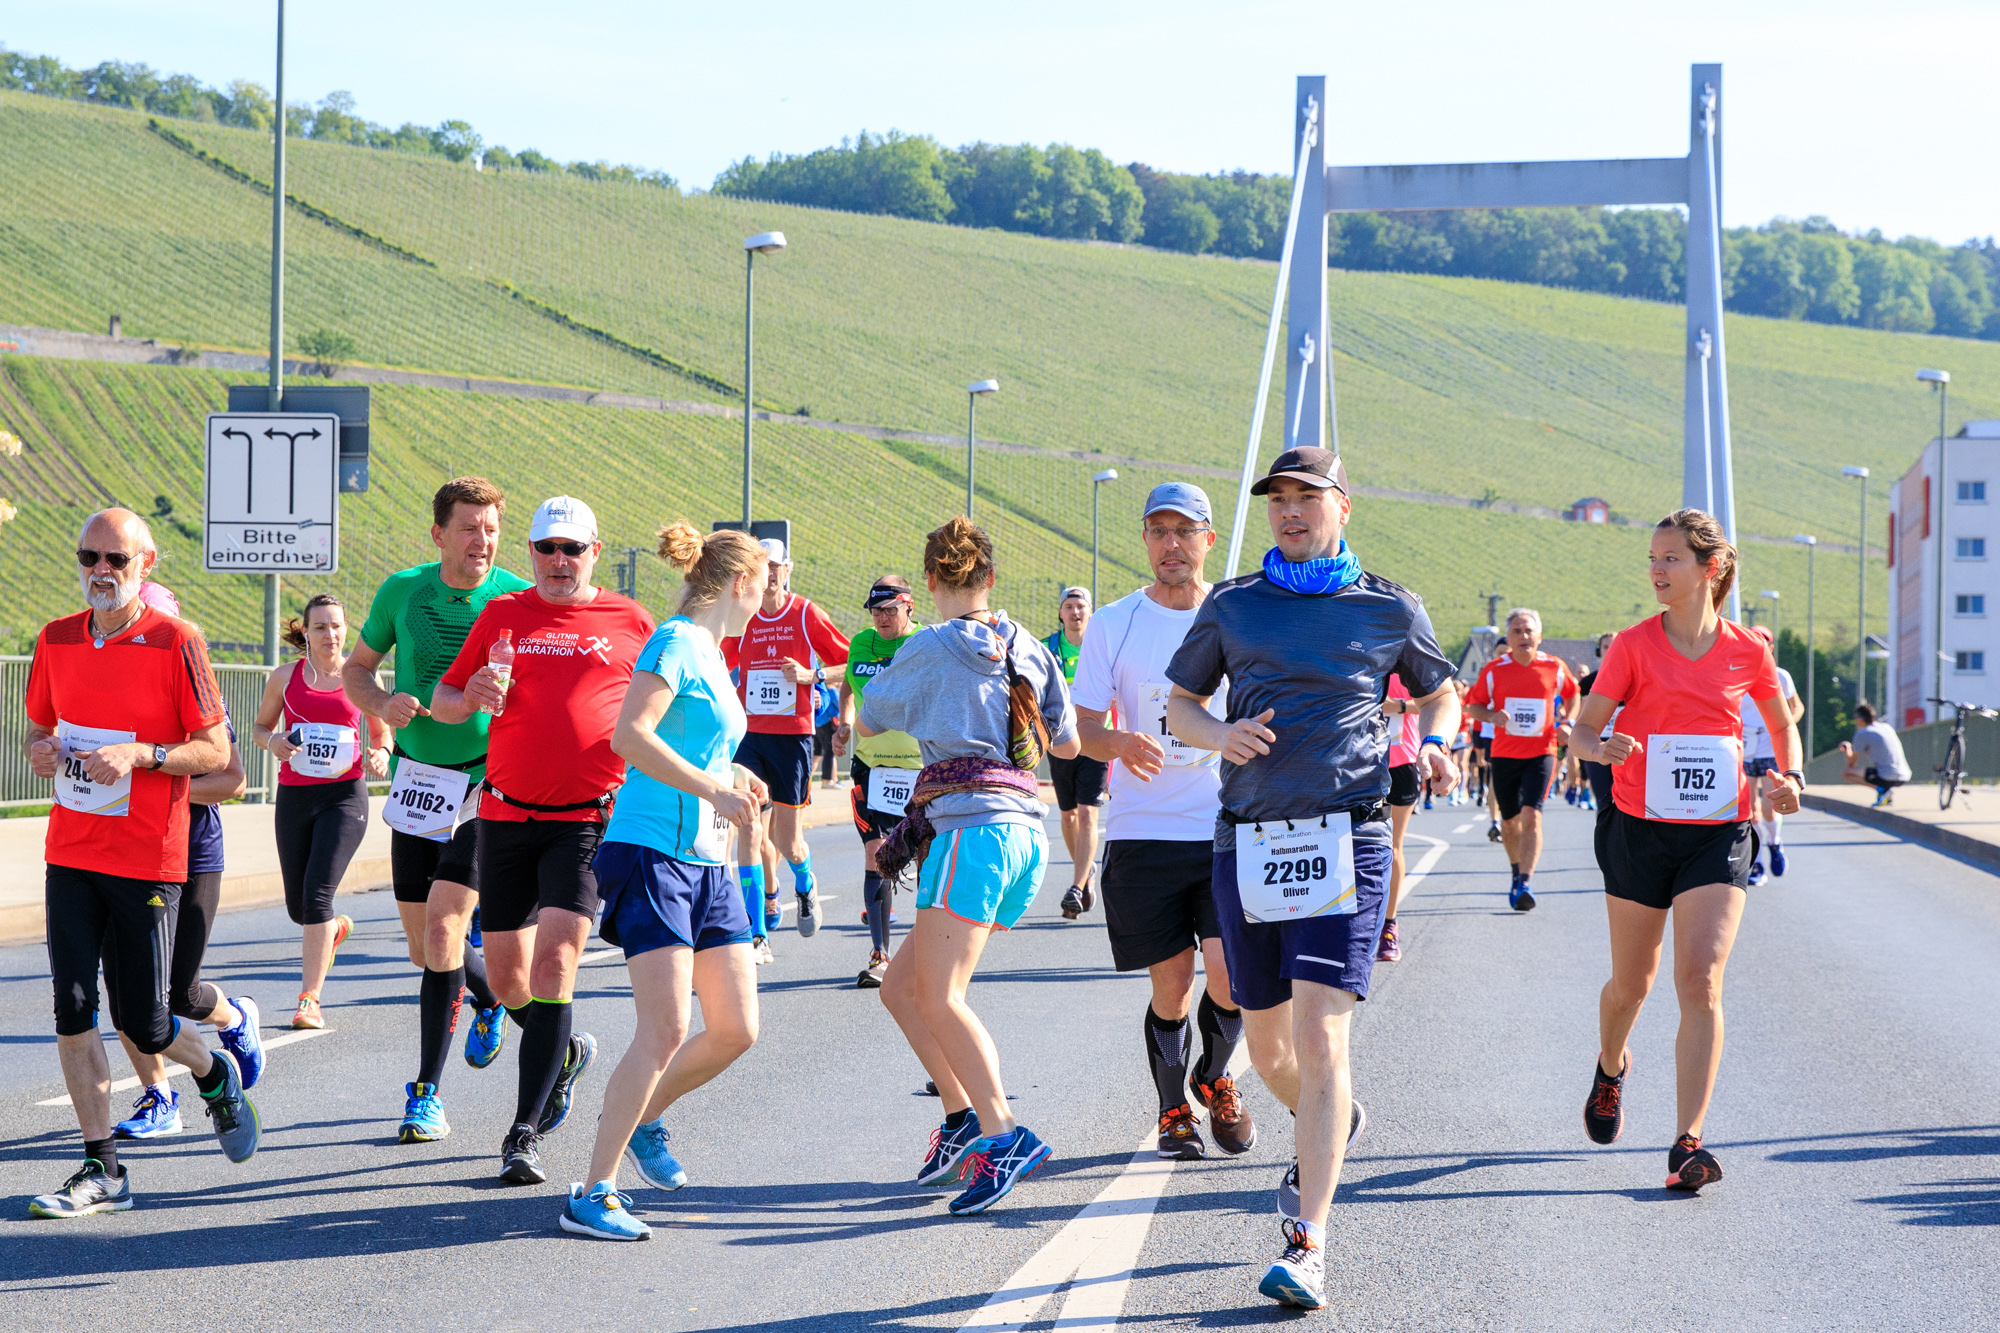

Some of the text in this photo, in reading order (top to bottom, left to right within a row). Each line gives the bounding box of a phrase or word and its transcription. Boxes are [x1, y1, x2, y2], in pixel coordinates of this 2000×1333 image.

[244, 529, 297, 544] Bitte
[546, 632, 580, 640] GLITNIR
[519, 638, 577, 647] COPENHAGEN
[517, 645, 574, 656] MARATHON
[761, 687, 780, 699] 319
[306, 743, 338, 759] 1537
[1671, 768, 1716, 789] 1752
[73, 784, 91, 794] Erwin
[883, 786, 910, 801] 2167
[400, 788, 445, 814] 10162
[1680, 792, 1708, 801] Désirée
[407, 810, 426, 821] Günter
[1271, 844, 1319, 855] Halbmarathon
[1264, 857, 1327, 885] 2299
[1283, 887, 1310, 898] Oliver
